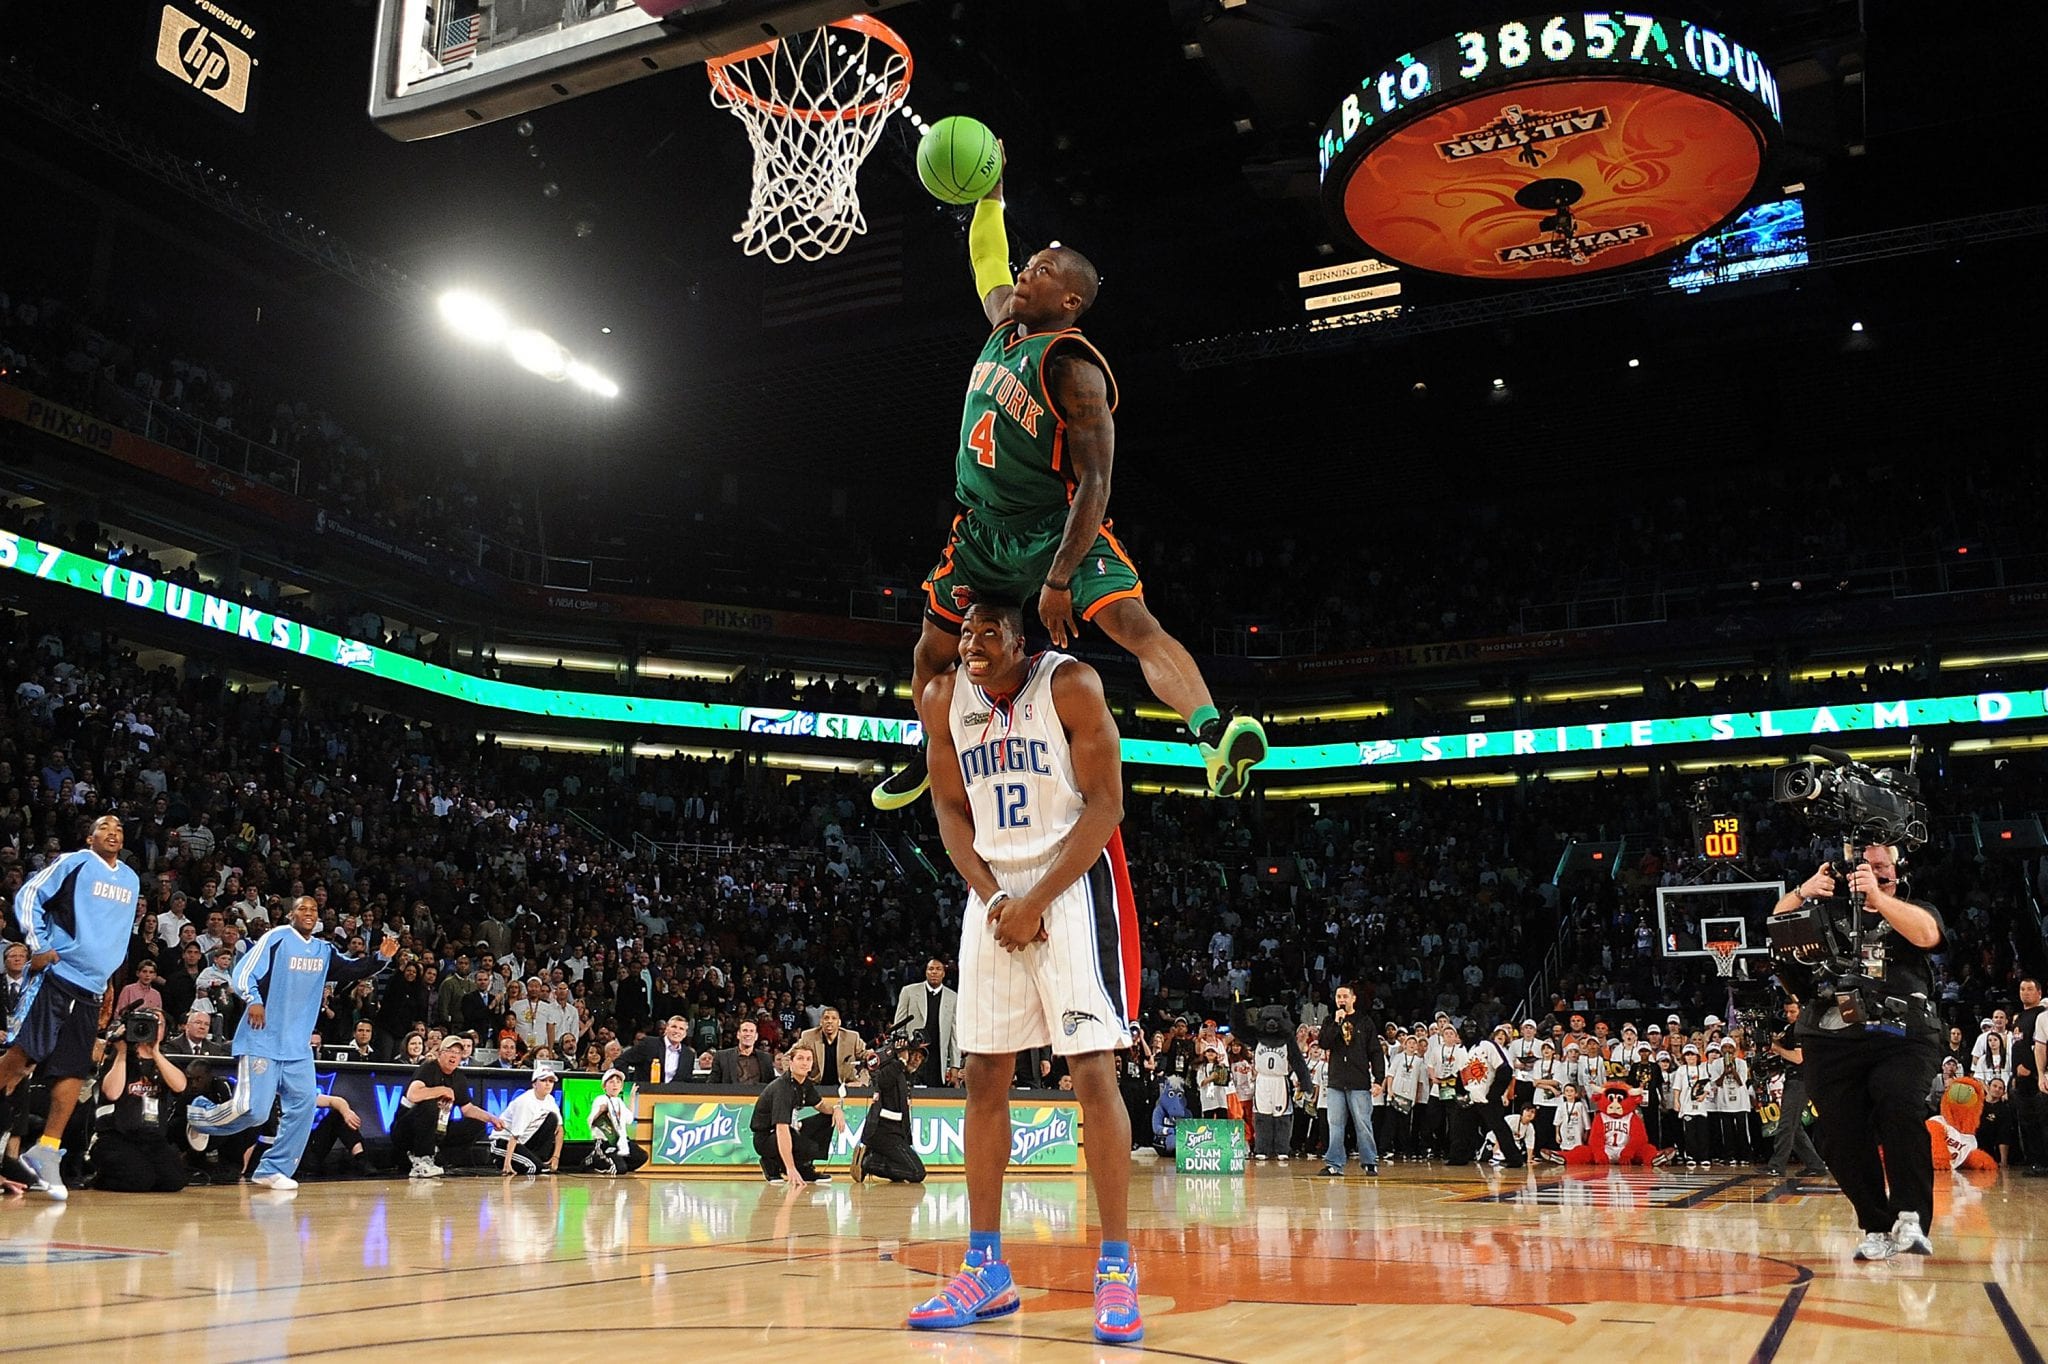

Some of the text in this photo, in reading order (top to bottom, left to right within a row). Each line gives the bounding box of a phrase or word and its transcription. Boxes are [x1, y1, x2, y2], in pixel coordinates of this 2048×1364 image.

[240, 24, 256, 39] by
[1458, 13, 1656, 78] 38657
[183, 26, 226, 89] hp
[1378, 62, 1429, 113] to
[1308, 266, 1358, 283] RUNNING
[1332, 290, 1374, 304] ROBINSON
[986, 365, 1045, 440] YORK
[968, 410, 998, 469] 4
[101, 563, 310, 656] (DUNKS)
[825, 717, 902, 744] SLAM
[1419, 719, 1653, 762] SPRITE
[1708, 699, 1910, 741] SLAM
[960, 736, 1052, 787] MAGC
[994, 782, 1031, 831] 12
[1705, 833, 1737, 857] 00
[288, 956, 325, 972] DENVER
[1268, 1056, 1275, 1070] 0
[665, 1110, 734, 1158] Sprite
[912, 1117, 965, 1157] UN
[1010, 1118, 1068, 1158] Sprite
[1604, 1120, 1629, 1135] BULLS
[1612, 1132, 1619, 1147] 1
[1185, 1157, 1221, 1171] DUNK
[1195, 1148, 1221, 1158] SLAM
